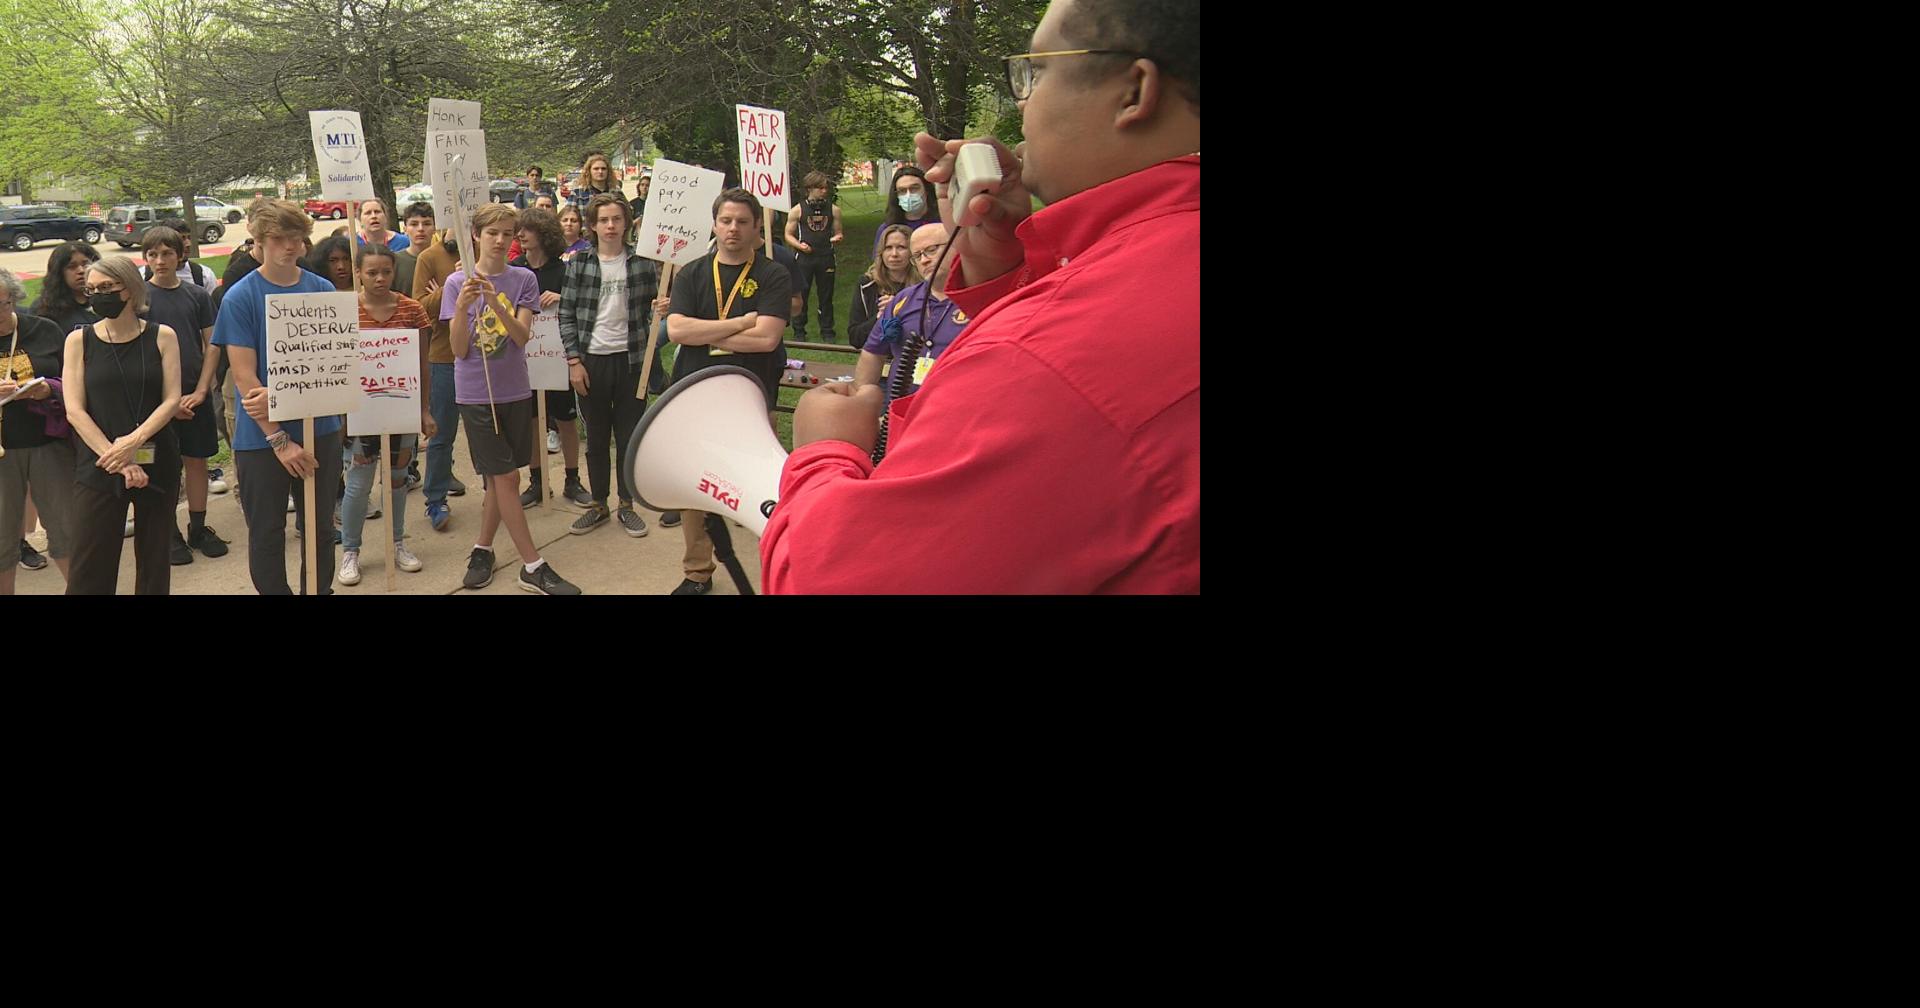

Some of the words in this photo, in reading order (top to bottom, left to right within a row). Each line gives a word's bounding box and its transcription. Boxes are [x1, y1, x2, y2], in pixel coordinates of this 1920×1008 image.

[432, 107, 466, 126] Honk
[739, 109, 780, 141] FAIR
[326, 133, 356, 146] MTI
[435, 134, 470, 149] FAIR
[445, 153, 466, 166] PY
[745, 139, 776, 166] PAY
[328, 173, 366, 183] Solidarity!
[744, 169, 784, 197] NOW
[446, 187, 481, 202] SFF
[658, 188, 685, 204] pay
[662, 203, 687, 215] for
[269, 300, 337, 320] Students
[286, 322, 359, 339] DESERVE
[274, 339, 332, 354] Qualified
[359, 336, 410, 349] eachers
[317, 363, 325, 373] is
[330, 361, 352, 373] not
[697, 478, 740, 511] PYLE
